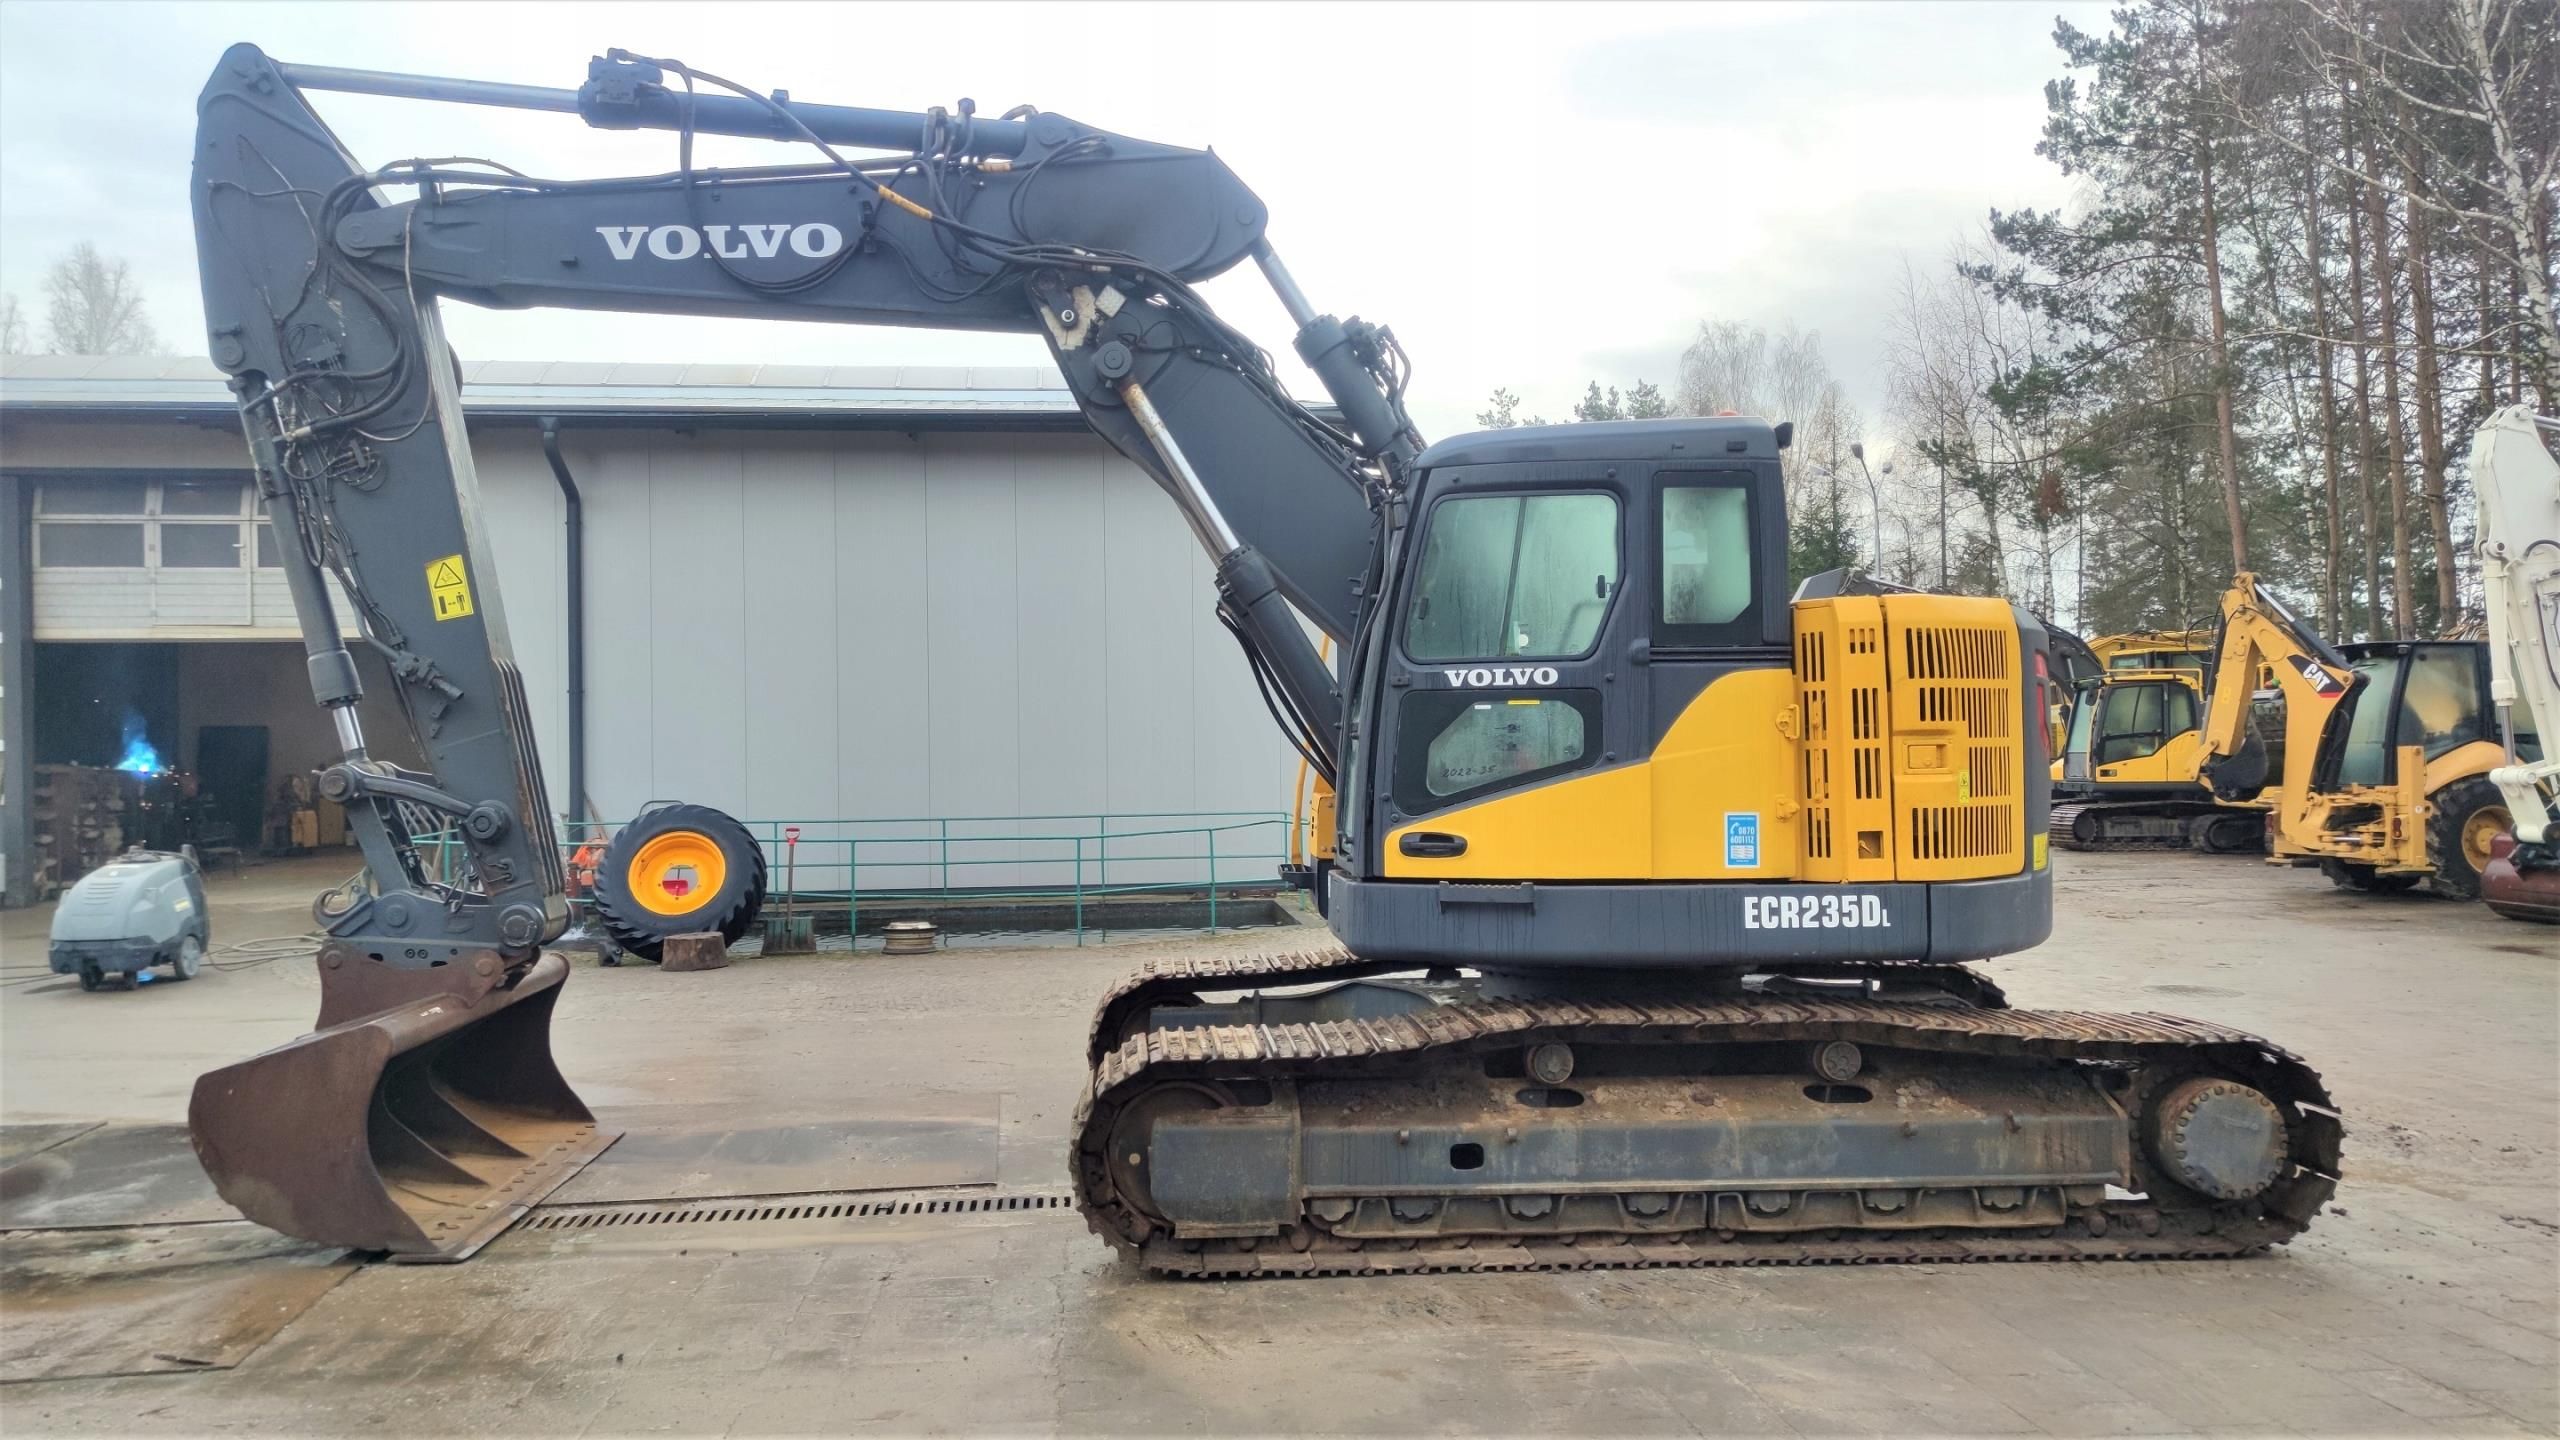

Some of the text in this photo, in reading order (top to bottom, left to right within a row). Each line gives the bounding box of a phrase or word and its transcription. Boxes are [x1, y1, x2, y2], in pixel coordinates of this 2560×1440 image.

[595, 222, 843, 261] VOLVO
[1444, 666, 1559, 688] VOLVO
[2302, 663, 2331, 692] CAT
